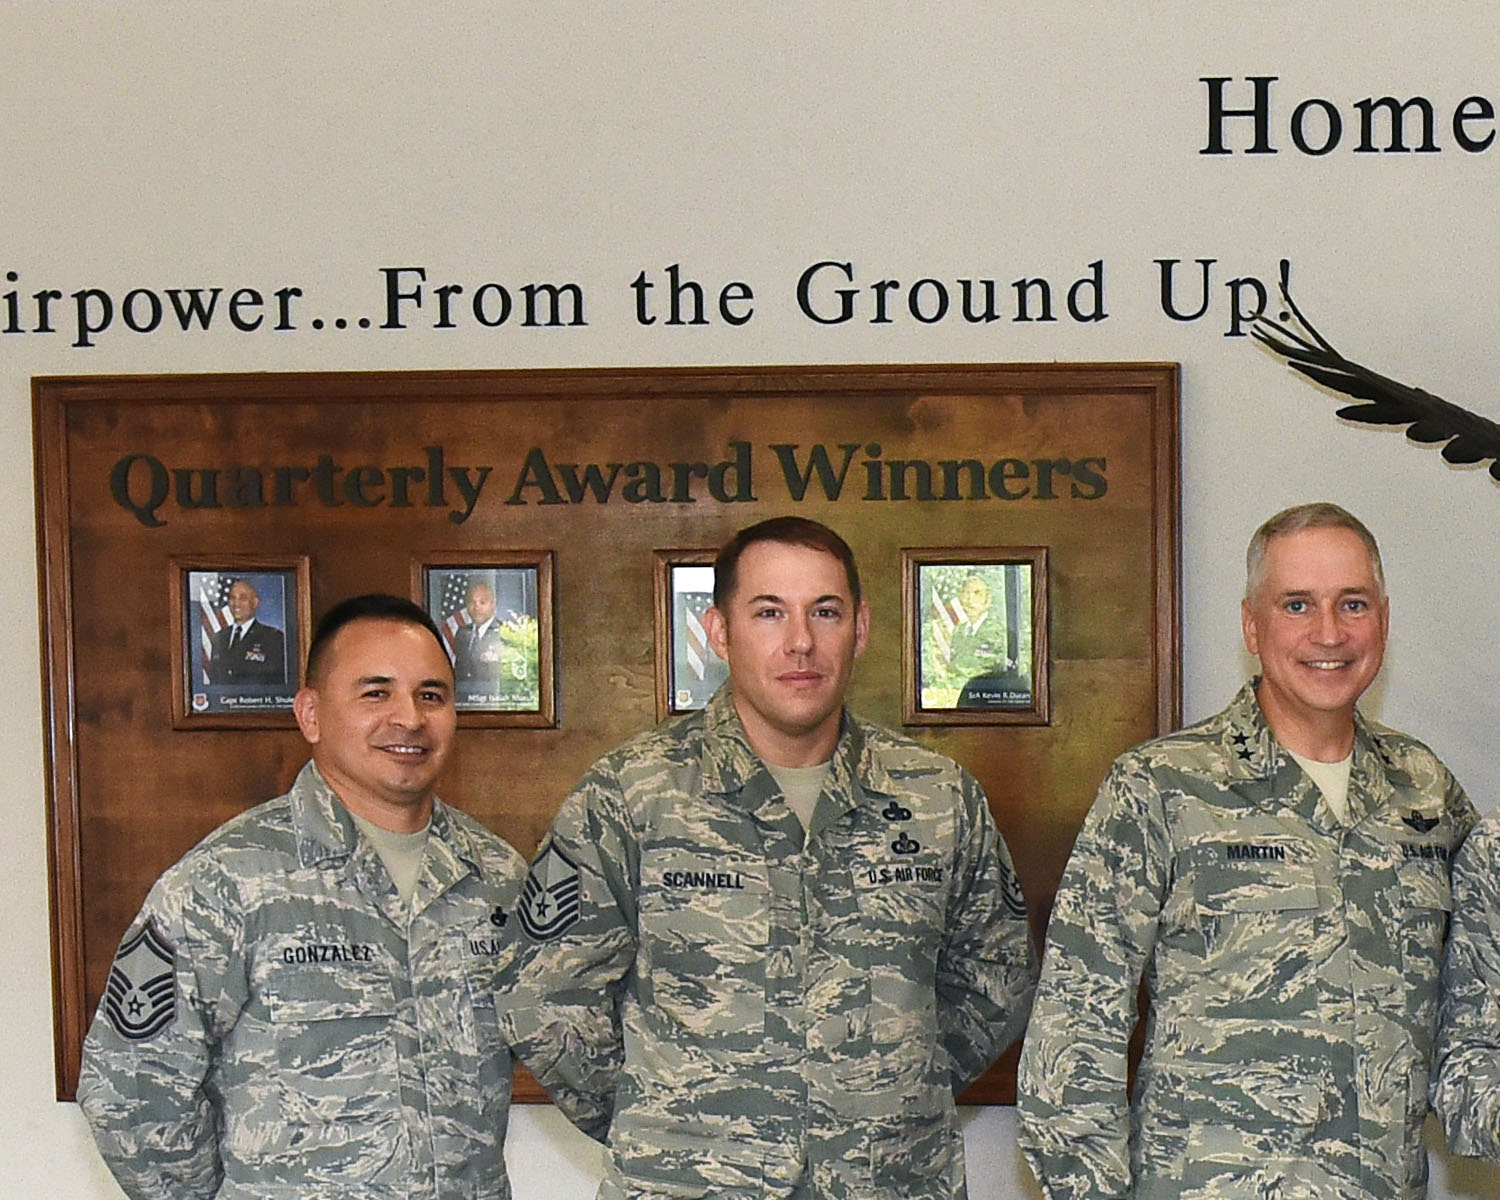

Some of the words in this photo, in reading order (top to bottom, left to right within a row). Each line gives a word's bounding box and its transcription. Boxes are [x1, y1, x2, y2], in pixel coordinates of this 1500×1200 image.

[1198, 75, 1497, 156] Home
[629, 264, 756, 327] the
[796, 259, 1110, 325] Ground
[1152, 258, 1291, 337] Up!
[109, 446, 495, 528] Quarterly
[503, 441, 758, 504] Award
[769, 442, 1108, 502] Winners
[1226, 845, 1285, 860] MARTIN
[663, 870, 744, 890] SCANNELL
[895, 867, 913, 882] AIR
[283, 943, 373, 965] GONZALEZ
